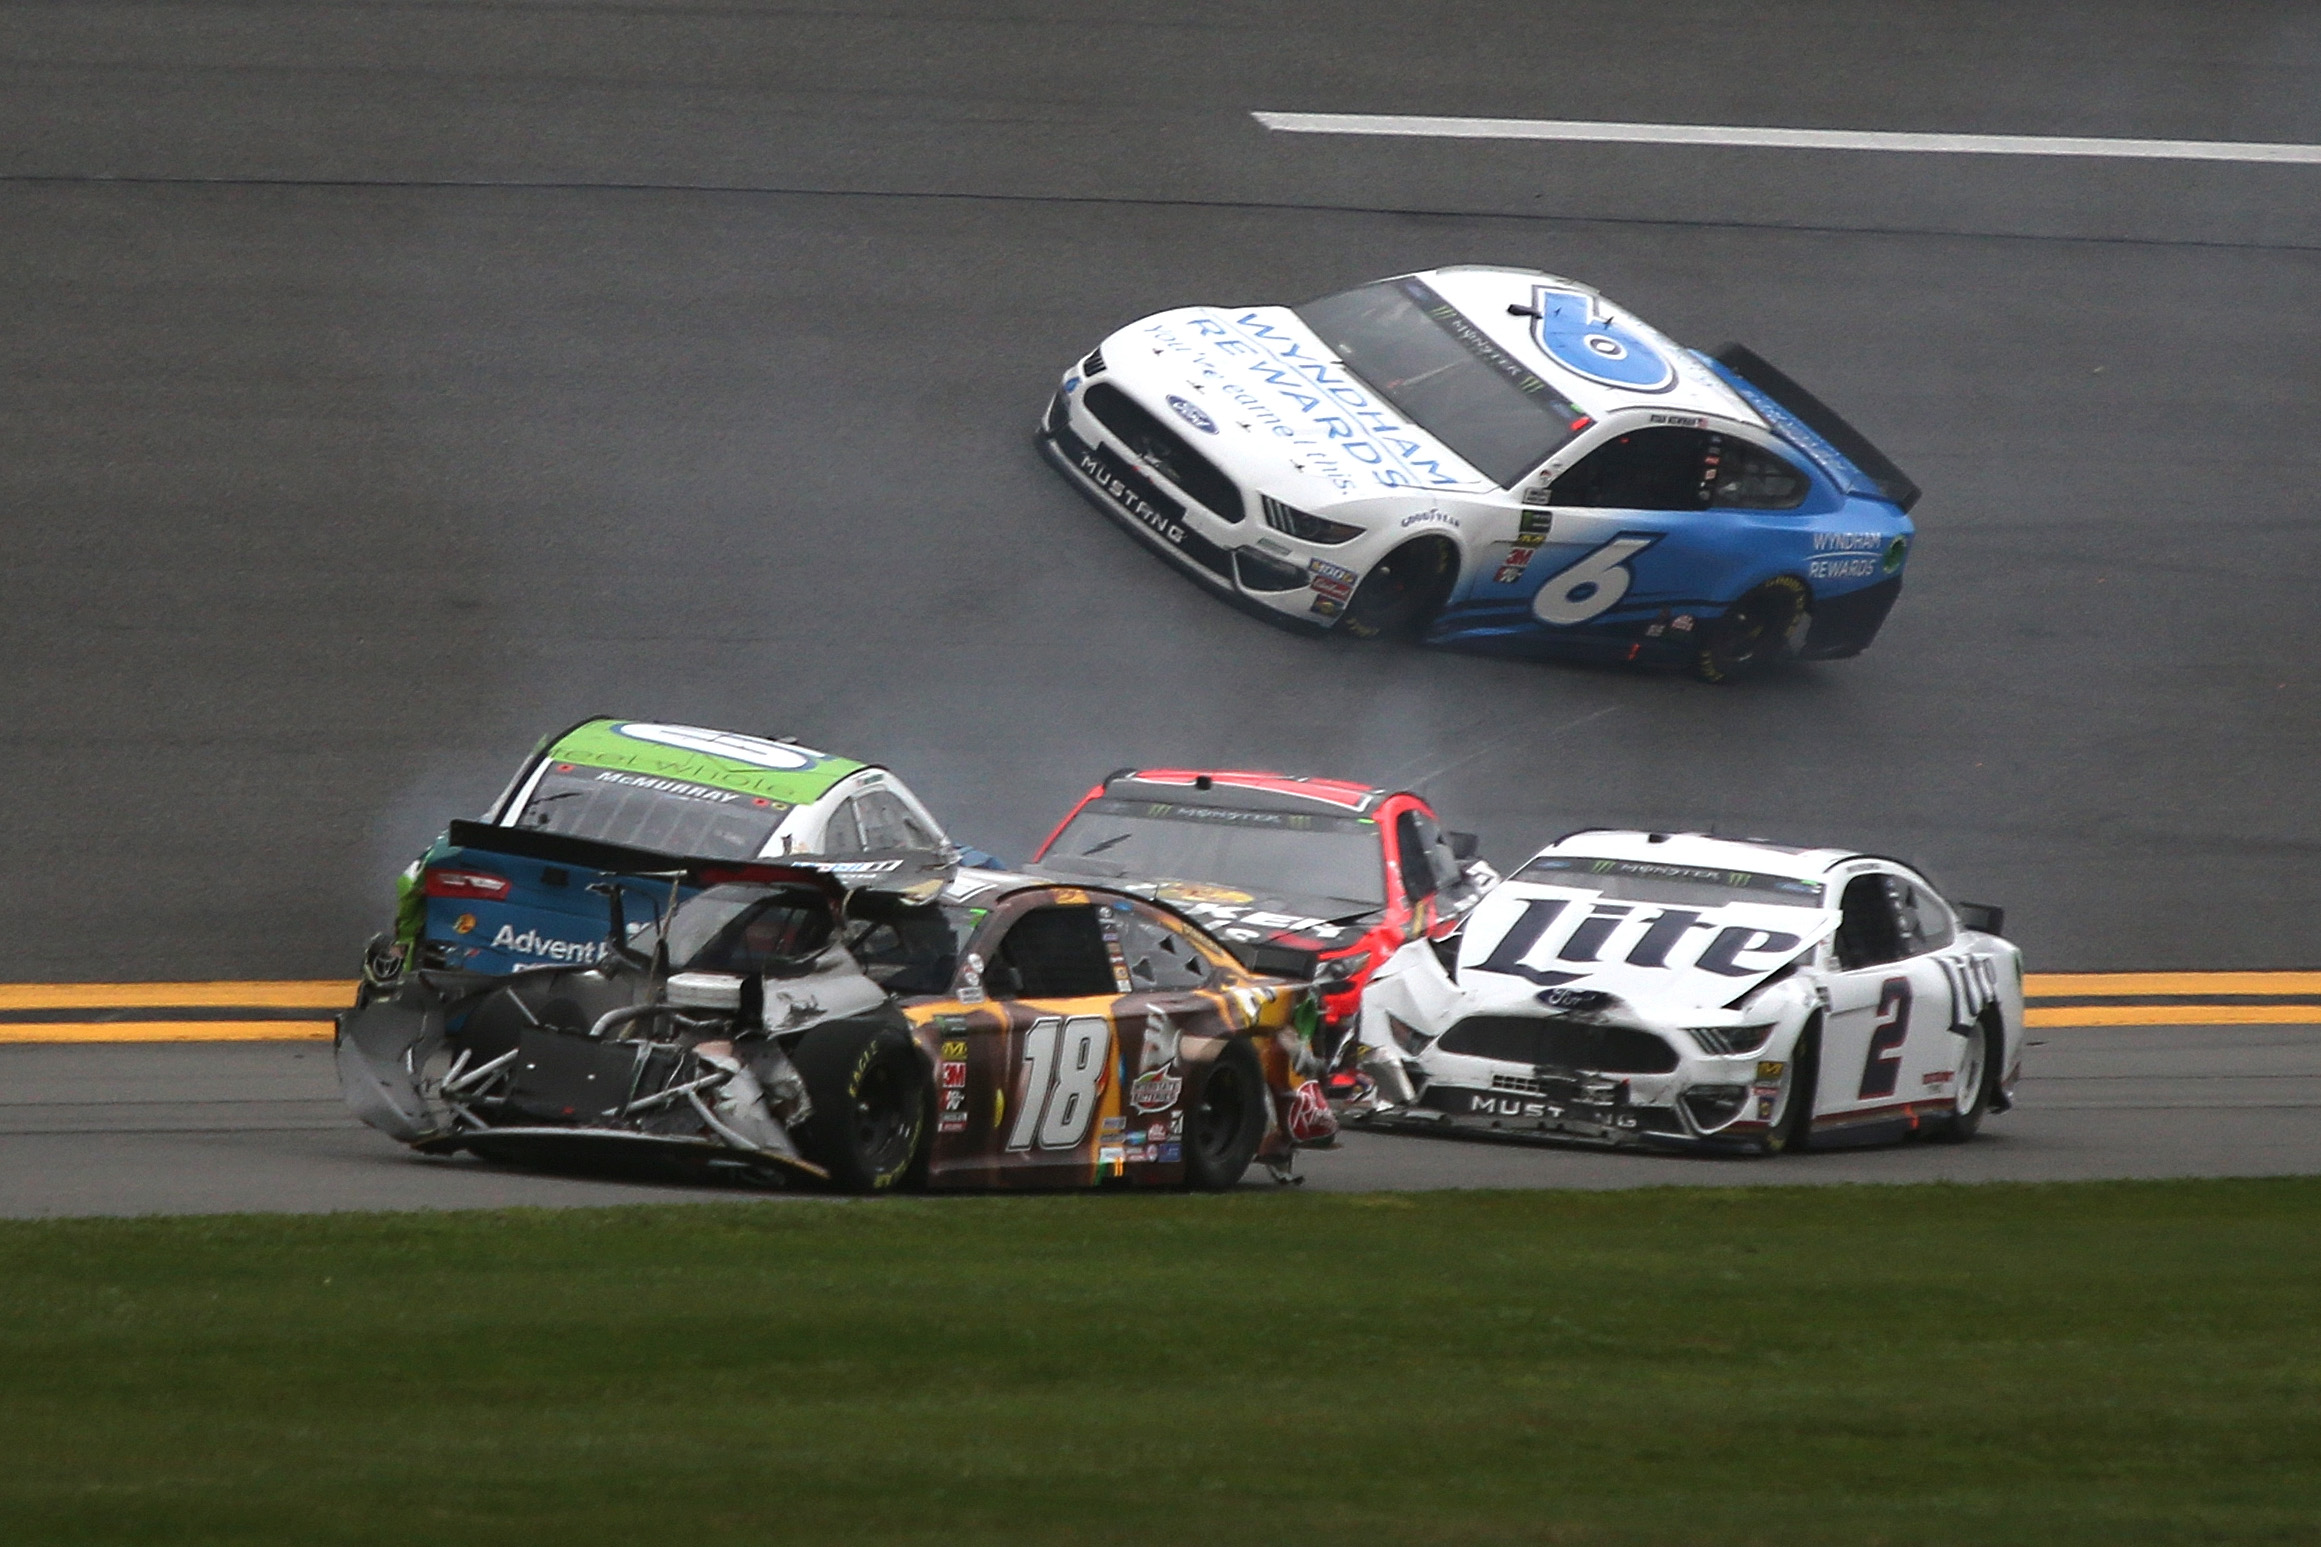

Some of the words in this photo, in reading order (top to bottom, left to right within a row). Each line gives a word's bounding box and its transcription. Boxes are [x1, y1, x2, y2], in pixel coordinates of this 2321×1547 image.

[1187, 318, 1409, 490] REWARDS
[1236, 312, 1457, 486] WYNDHAM
[1081, 455, 1187, 543] MUSTANG
[1813, 531, 1882, 550] WYNDHAM
[1533, 533, 1662, 625] 6
[1809, 559, 1877, 578] REWARDS
[595, 771, 740, 803] McMURRAY
[1620, 862, 1720, 881] MONSTER
[1461, 898, 1802, 987] Lite
[1005, 1013, 1111, 1152] 18
[1857, 976, 1912, 1101] 2
[1472, 1095, 1637, 1127] MUSTNG
